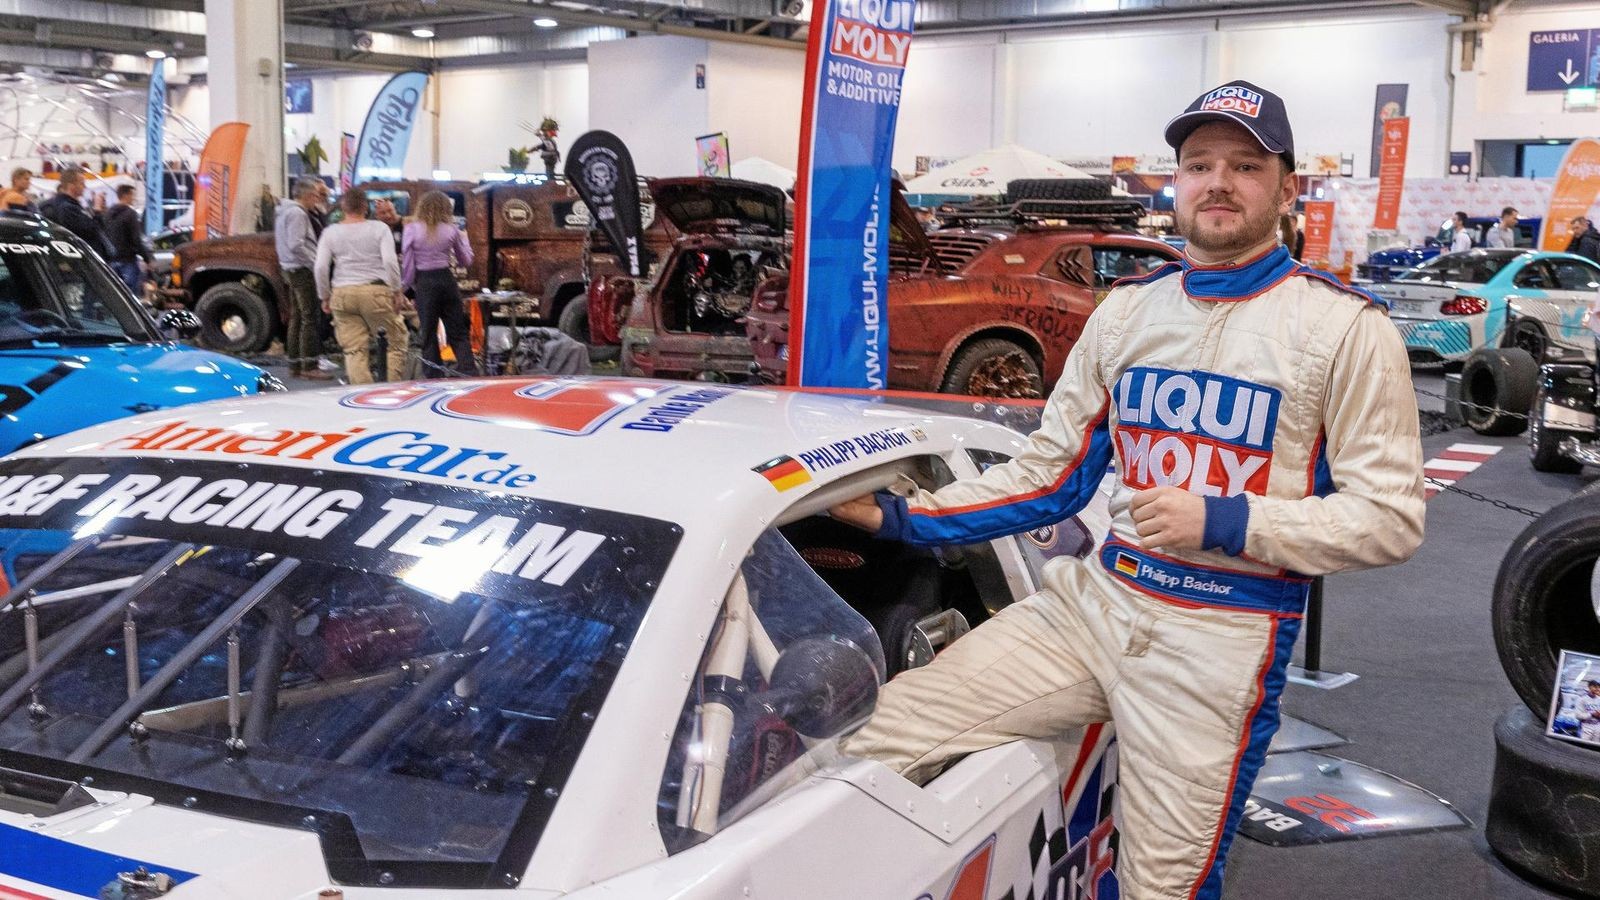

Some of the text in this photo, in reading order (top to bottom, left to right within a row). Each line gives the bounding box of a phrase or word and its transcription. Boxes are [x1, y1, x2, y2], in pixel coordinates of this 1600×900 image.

[840, 0, 911, 31] LIQUI
[834, 21, 911, 65] MOLY
[1532, 32, 1580, 44] GALERIA
[828, 60, 873, 86] MOTOR
[1205, 97, 1258, 114] MOLY
[1207, 88, 1258, 103] LIQUI
[991, 280, 1033, 304] WHY
[1047, 293, 1069, 316] SO
[620, 402, 705, 432] Danke
[1119, 371, 1272, 446] LIQUI
[98, 421, 537, 489] AmeriCar.de
[798, 439, 859, 472] PHILIPP
[1118, 430, 1269, 498] MOLY
[75, 473, 364, 541] RACING
[353, 497, 607, 588] TEAM
[1140, 564, 1234, 596] Philipp Bachor
